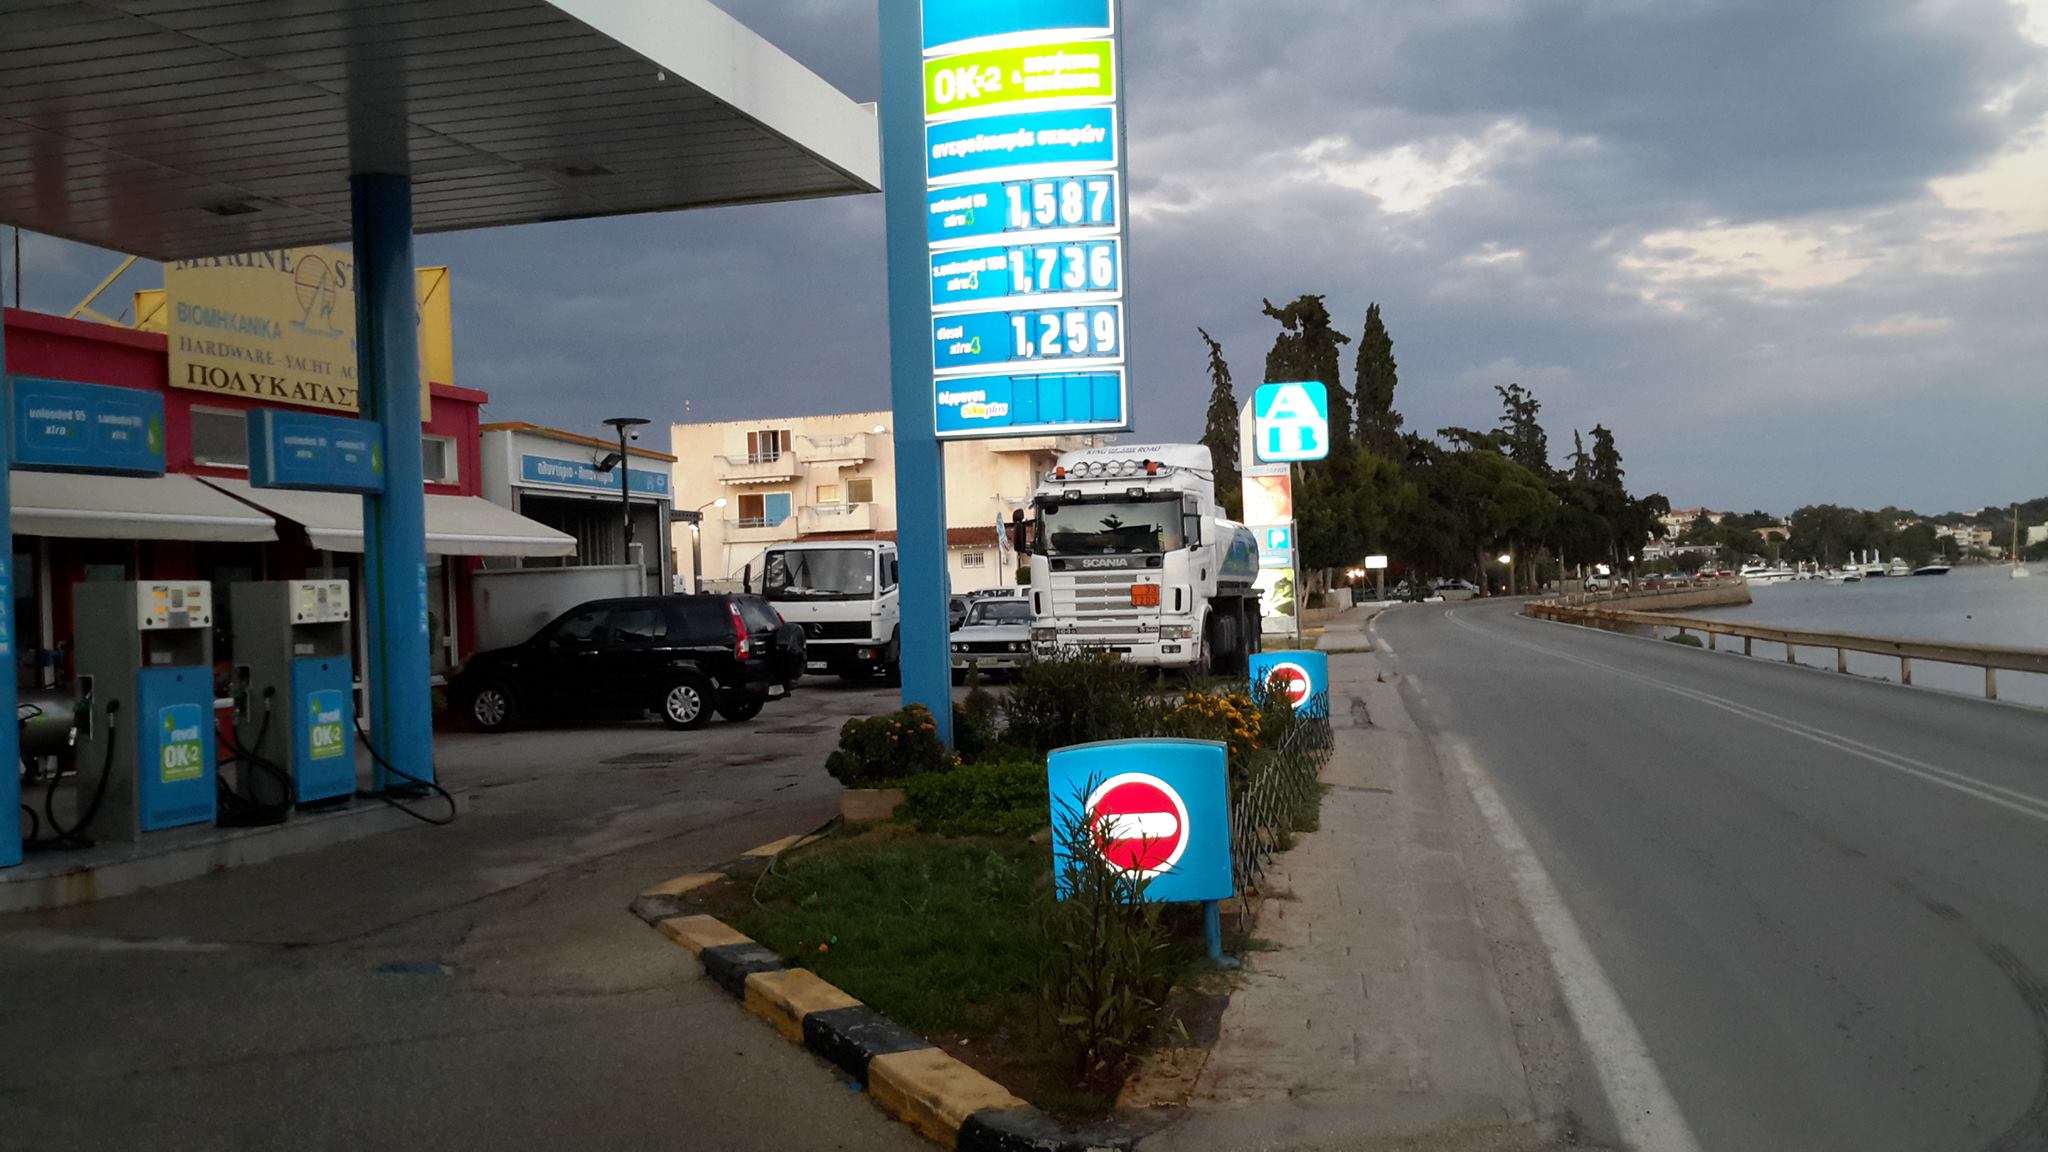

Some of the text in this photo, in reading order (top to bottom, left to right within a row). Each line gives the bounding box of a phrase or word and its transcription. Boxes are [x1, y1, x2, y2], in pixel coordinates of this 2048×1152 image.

[1006, 181, 1109, 228] 1,587
[1009, 246, 1112, 294] 1,736
[179, 335, 275, 365] HARDWARE
[285, 354, 333, 375] YACHT
[1011, 311, 1115, 359] 1,259
[1082, 557, 1128, 568] SCANIA
